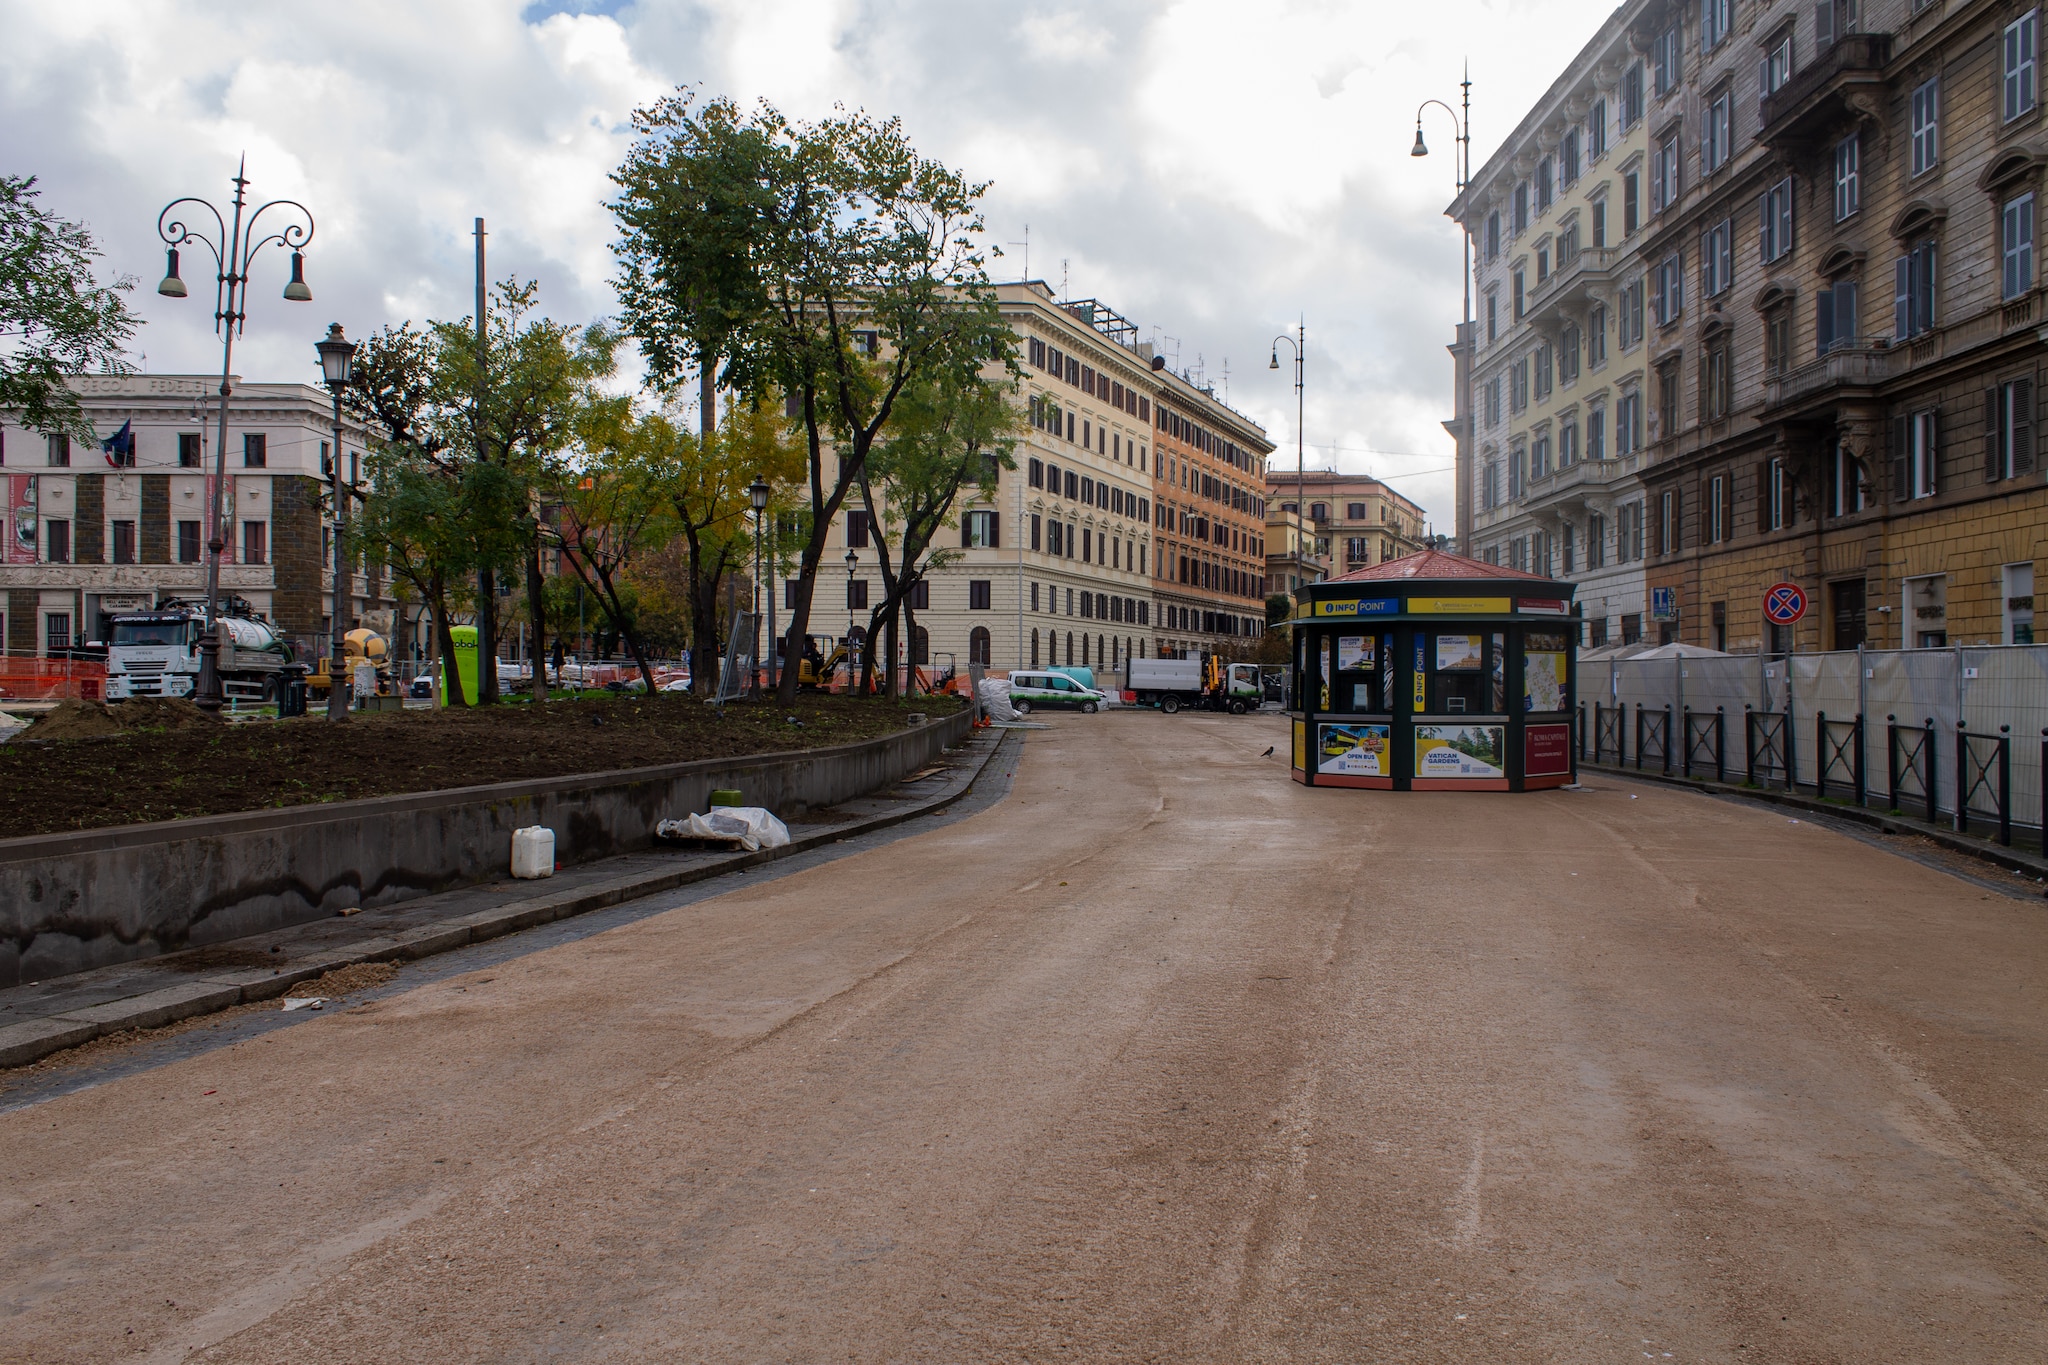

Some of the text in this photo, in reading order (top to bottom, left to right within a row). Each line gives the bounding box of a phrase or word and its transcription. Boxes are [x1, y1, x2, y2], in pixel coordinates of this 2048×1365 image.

[81, 380, 202, 393] SECOLI FEDELE
[1335, 601, 1386, 612] INFO POINT
[1416, 647, 1424, 671] POINT
